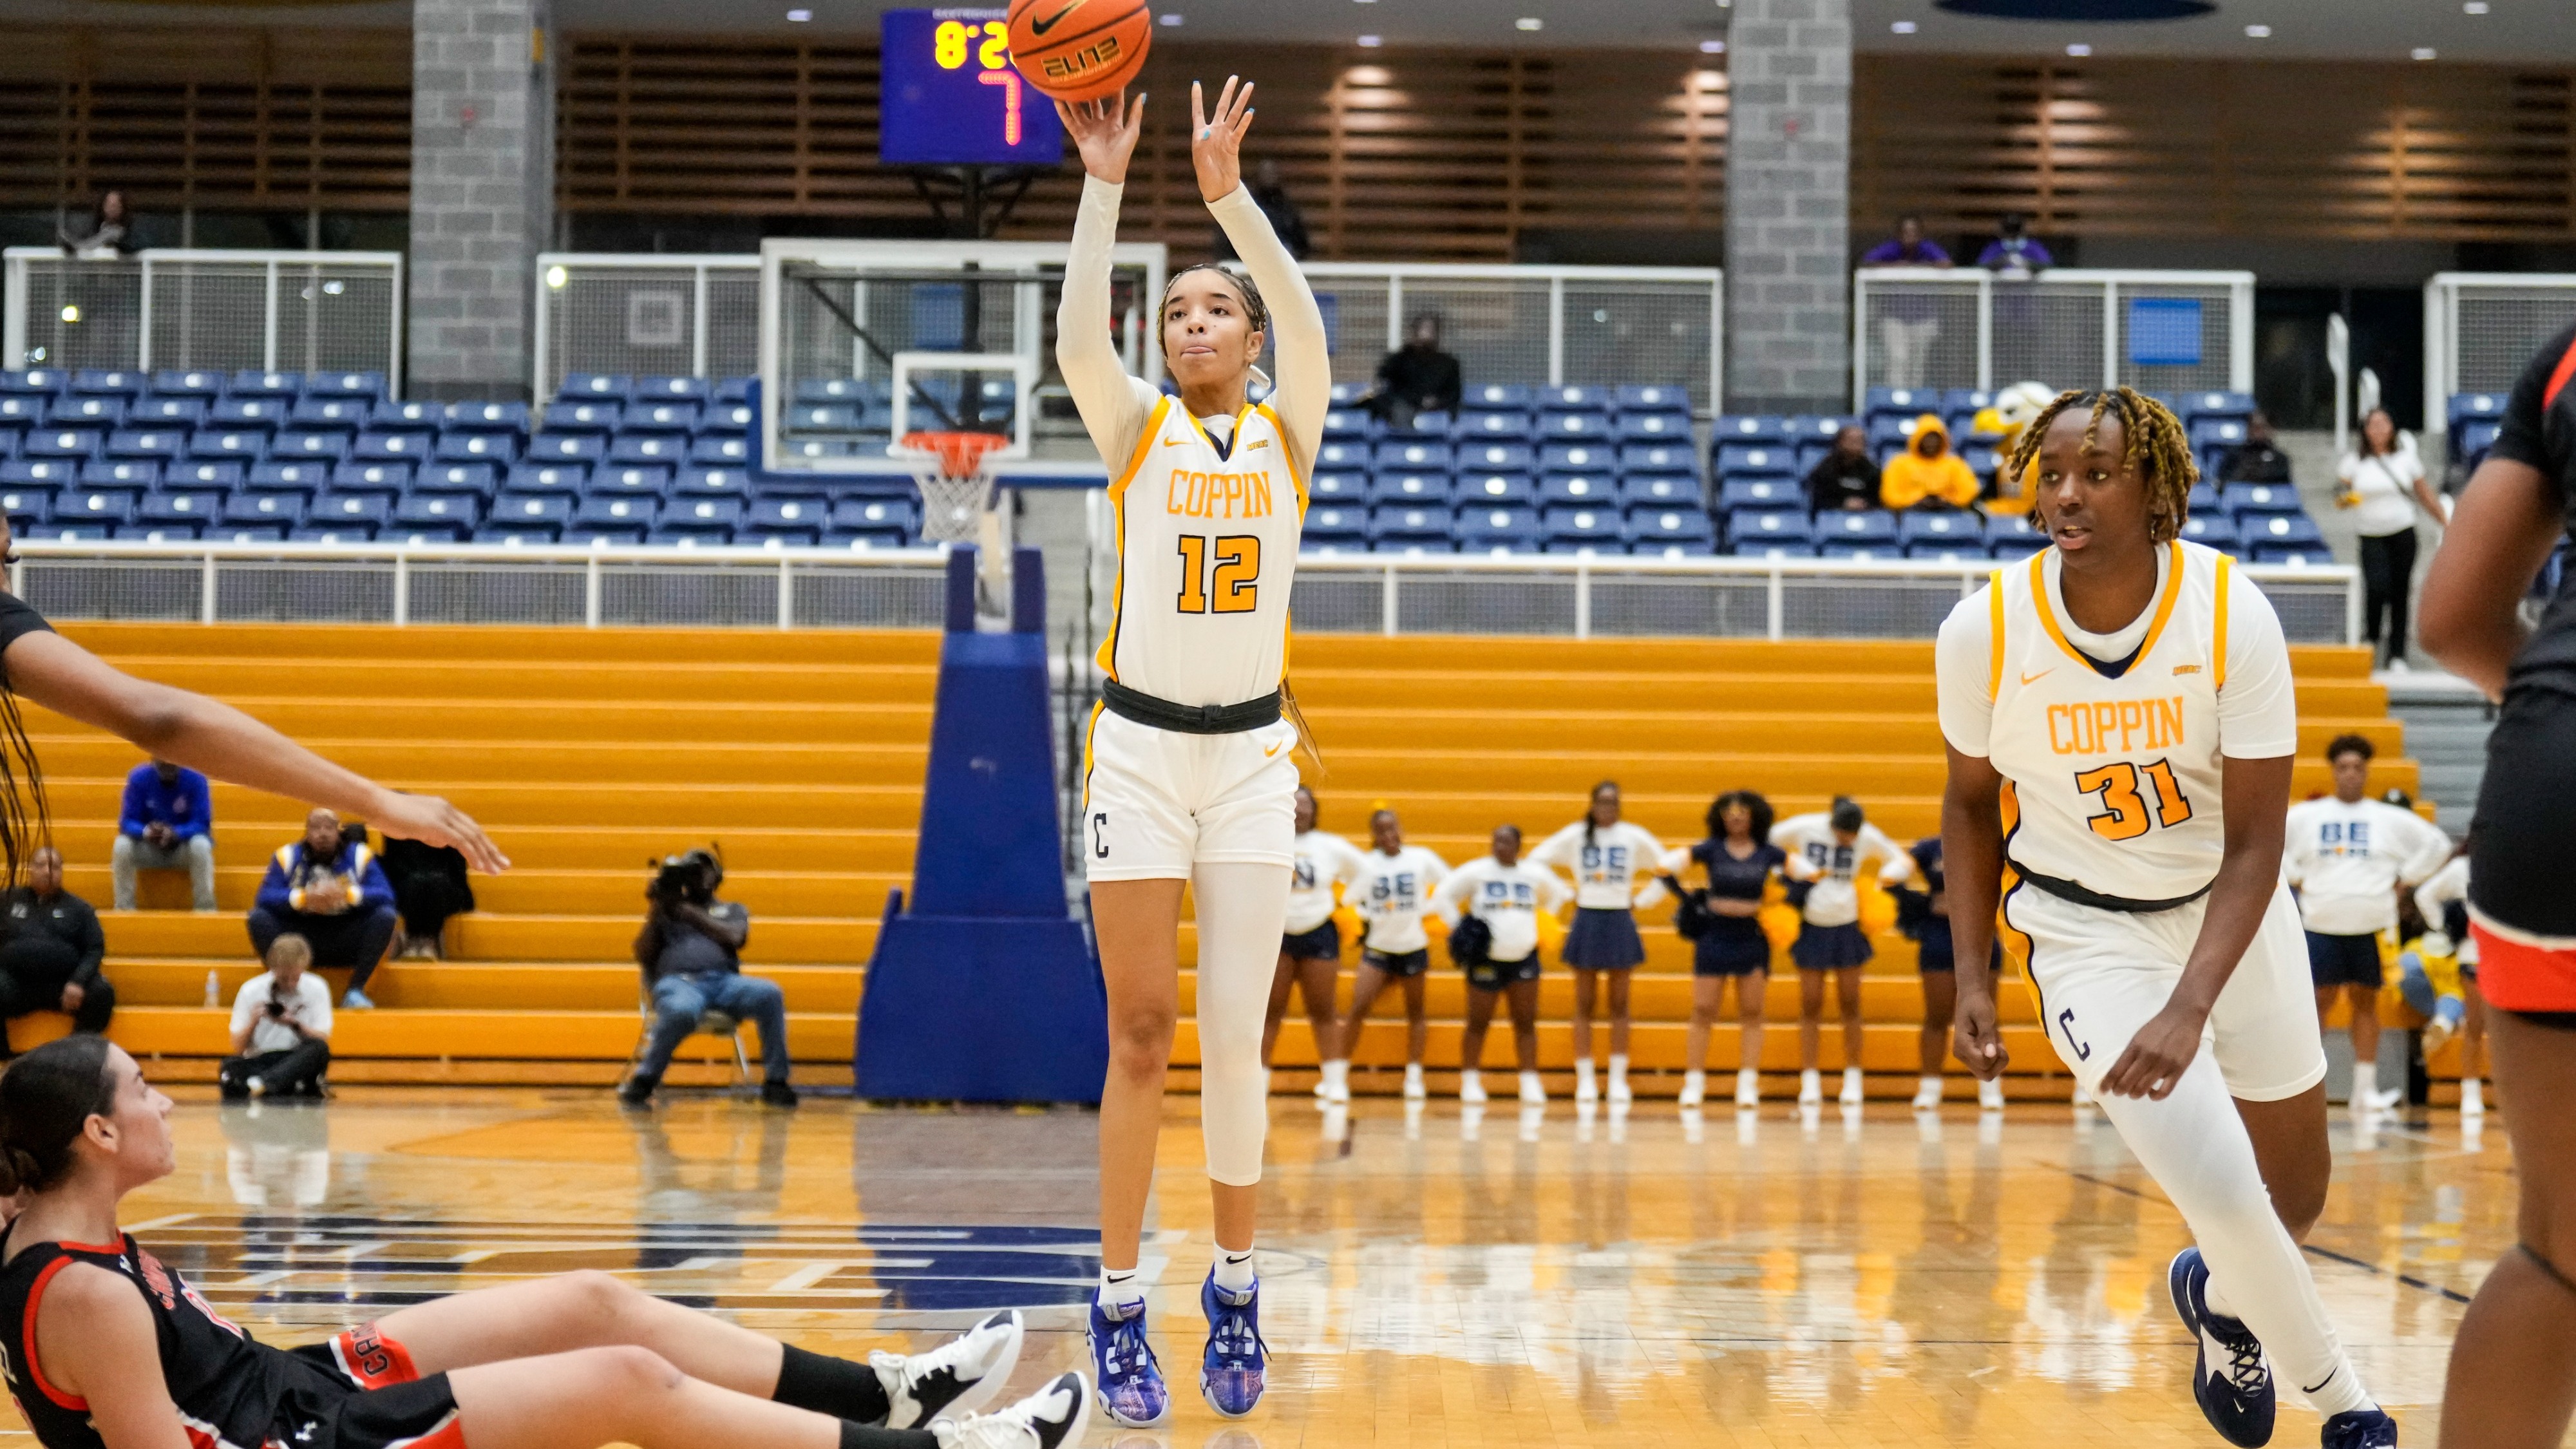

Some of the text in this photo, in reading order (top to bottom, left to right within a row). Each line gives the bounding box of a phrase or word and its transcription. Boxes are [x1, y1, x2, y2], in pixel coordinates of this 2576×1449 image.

[1041, 36, 1121, 77] ELITE
[978, 70, 1021, 146] 7
[1247, 439, 1268, 451] MEAC
[1167, 469, 1272, 519] COPPIN
[1177, 535, 1260, 614] 12
[2047, 697, 2183, 755] COPPIN
[2074, 757, 2192, 841] 31
[1094, 813, 1109, 858] C
[2321, 822, 2370, 844] BE
[2060, 1008, 2090, 1062] C
